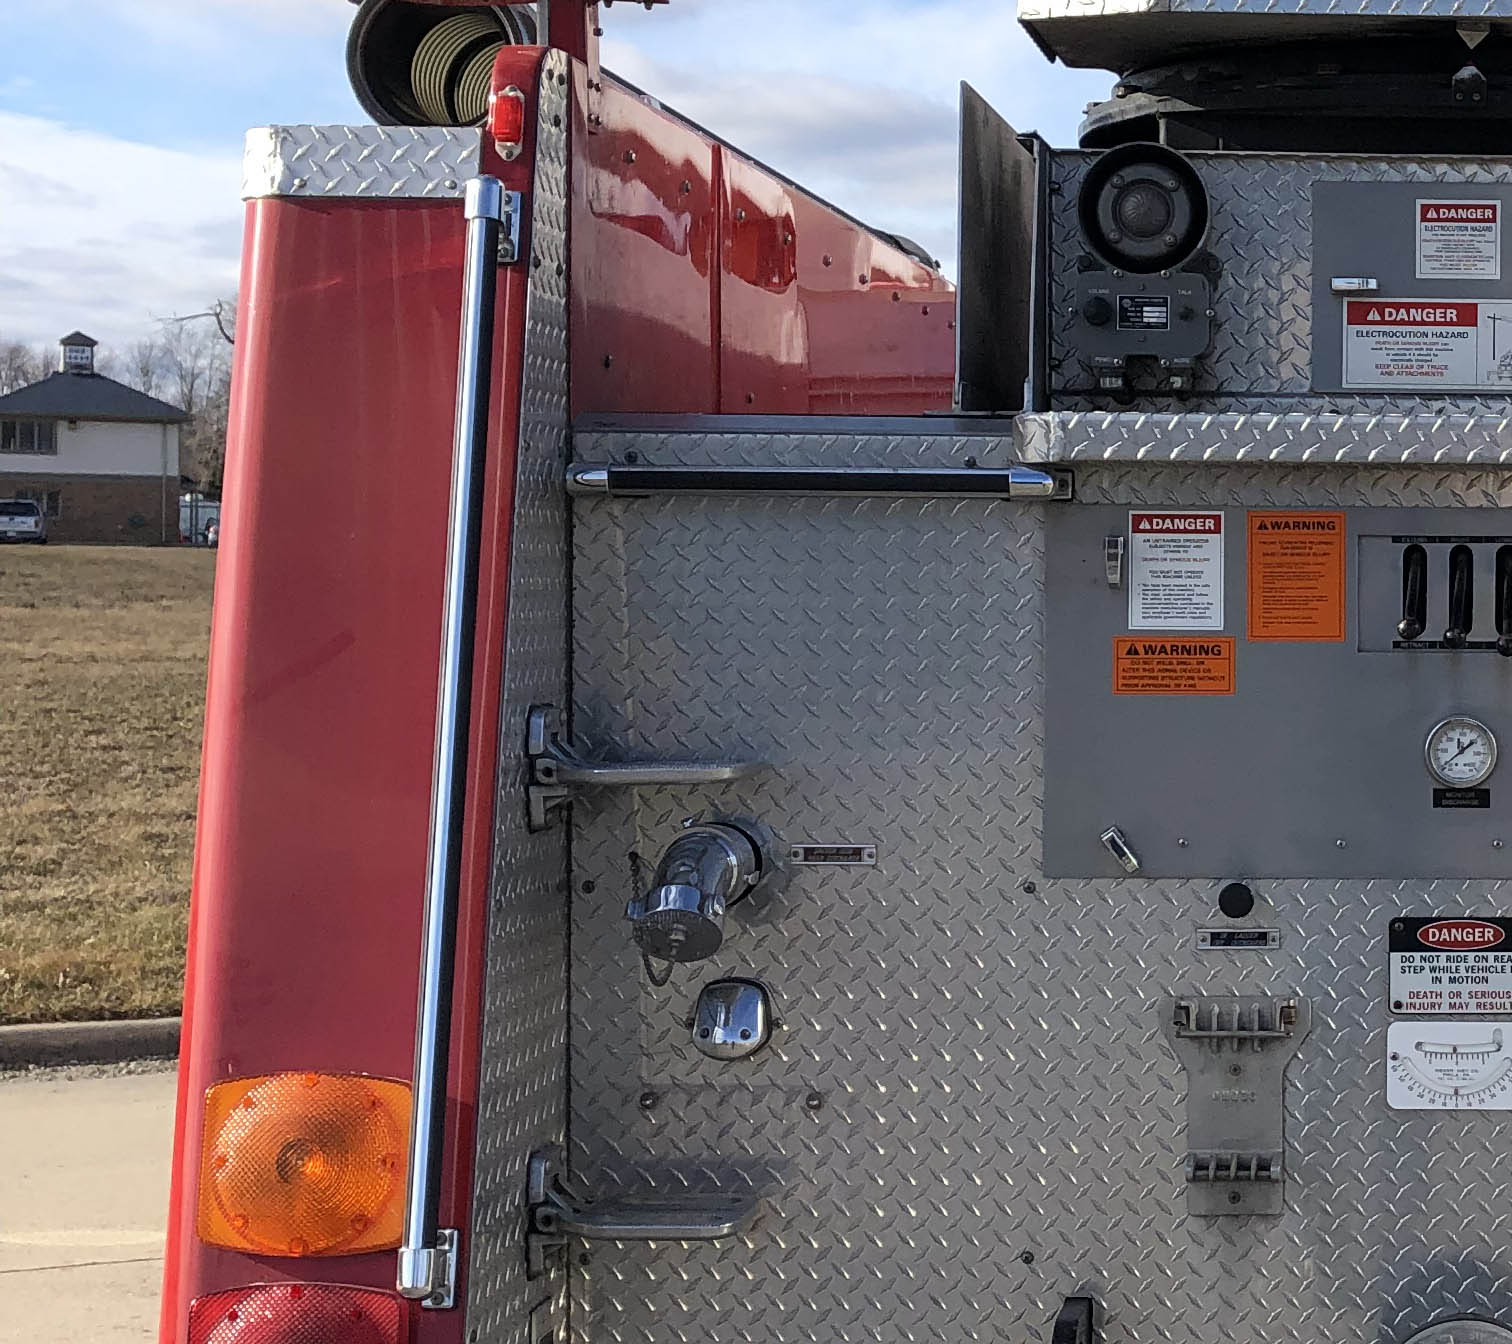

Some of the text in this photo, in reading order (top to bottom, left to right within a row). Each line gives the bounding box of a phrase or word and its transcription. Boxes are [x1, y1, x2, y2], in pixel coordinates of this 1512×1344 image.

[1440, 208, 1493, 219] DANGER
[1384, 307, 1458, 322] DANGER
[1355, 329, 1469, 339] ELECTROCUTION HAZARD
[1152, 518, 1215, 530] DANGER
[1270, 520, 1336, 531] WARNING
[1142, 644, 1222, 656] WARNING
[1428, 928, 1494, 942] DANGER
[1400, 955, 1414, 963] DO
[1420, 955, 1441, 963] NOT
[1445, 955, 1469, 963] RIDE
[1473, 955, 1489, 963] ON
[1400, 965, 1425, 974] STEP
[1429, 965, 1461, 974] WHILE
[1464, 965, 1506, 974] VEHICLE
[1431, 975, 1489, 984] IN MOTION
[1408, 991, 1512, 999] DEATH OR SERIOUS
[1405, 1001, 1443, 1011] INJURY
[1448, 1001, 1470, 1011] MAY
